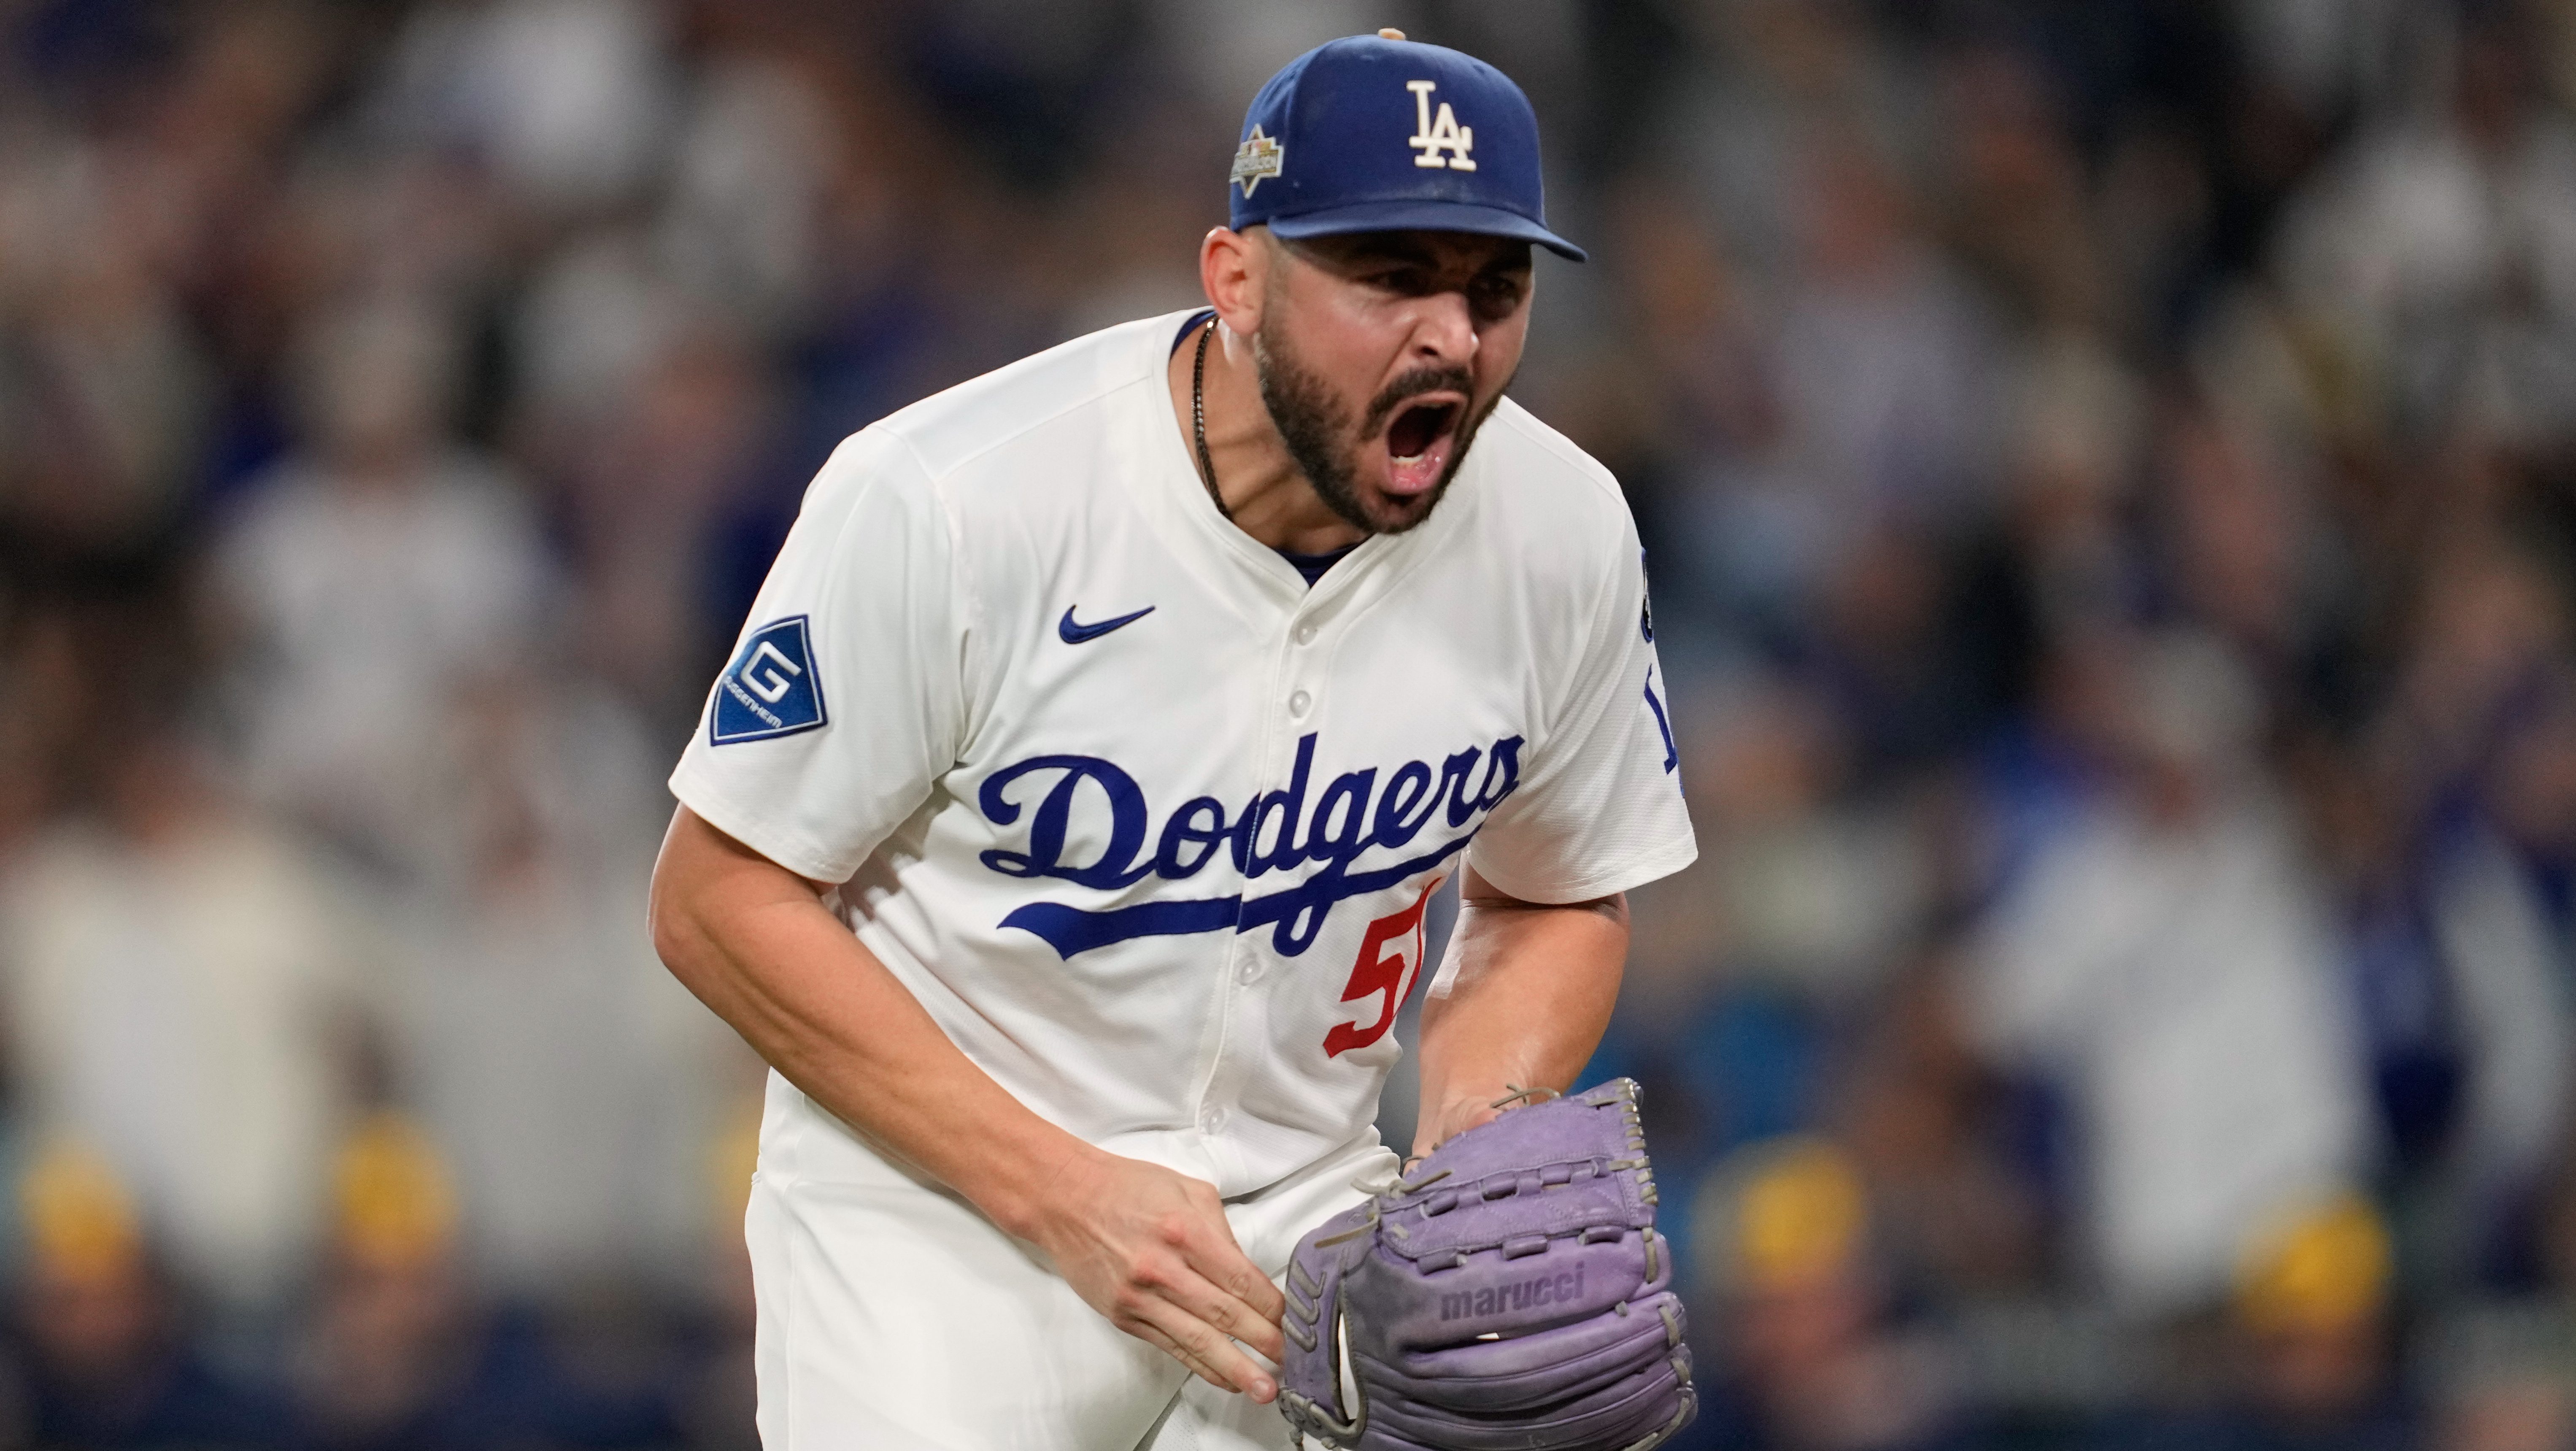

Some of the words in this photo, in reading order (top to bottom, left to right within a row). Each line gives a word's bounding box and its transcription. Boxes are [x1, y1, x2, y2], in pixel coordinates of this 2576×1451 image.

[1406, 80, 1477, 172] LA
[741, 641, 802, 704] G
[979, 732, 1526, 957] Dodgers
[1441, 1261, 1585, 1321] marucci
